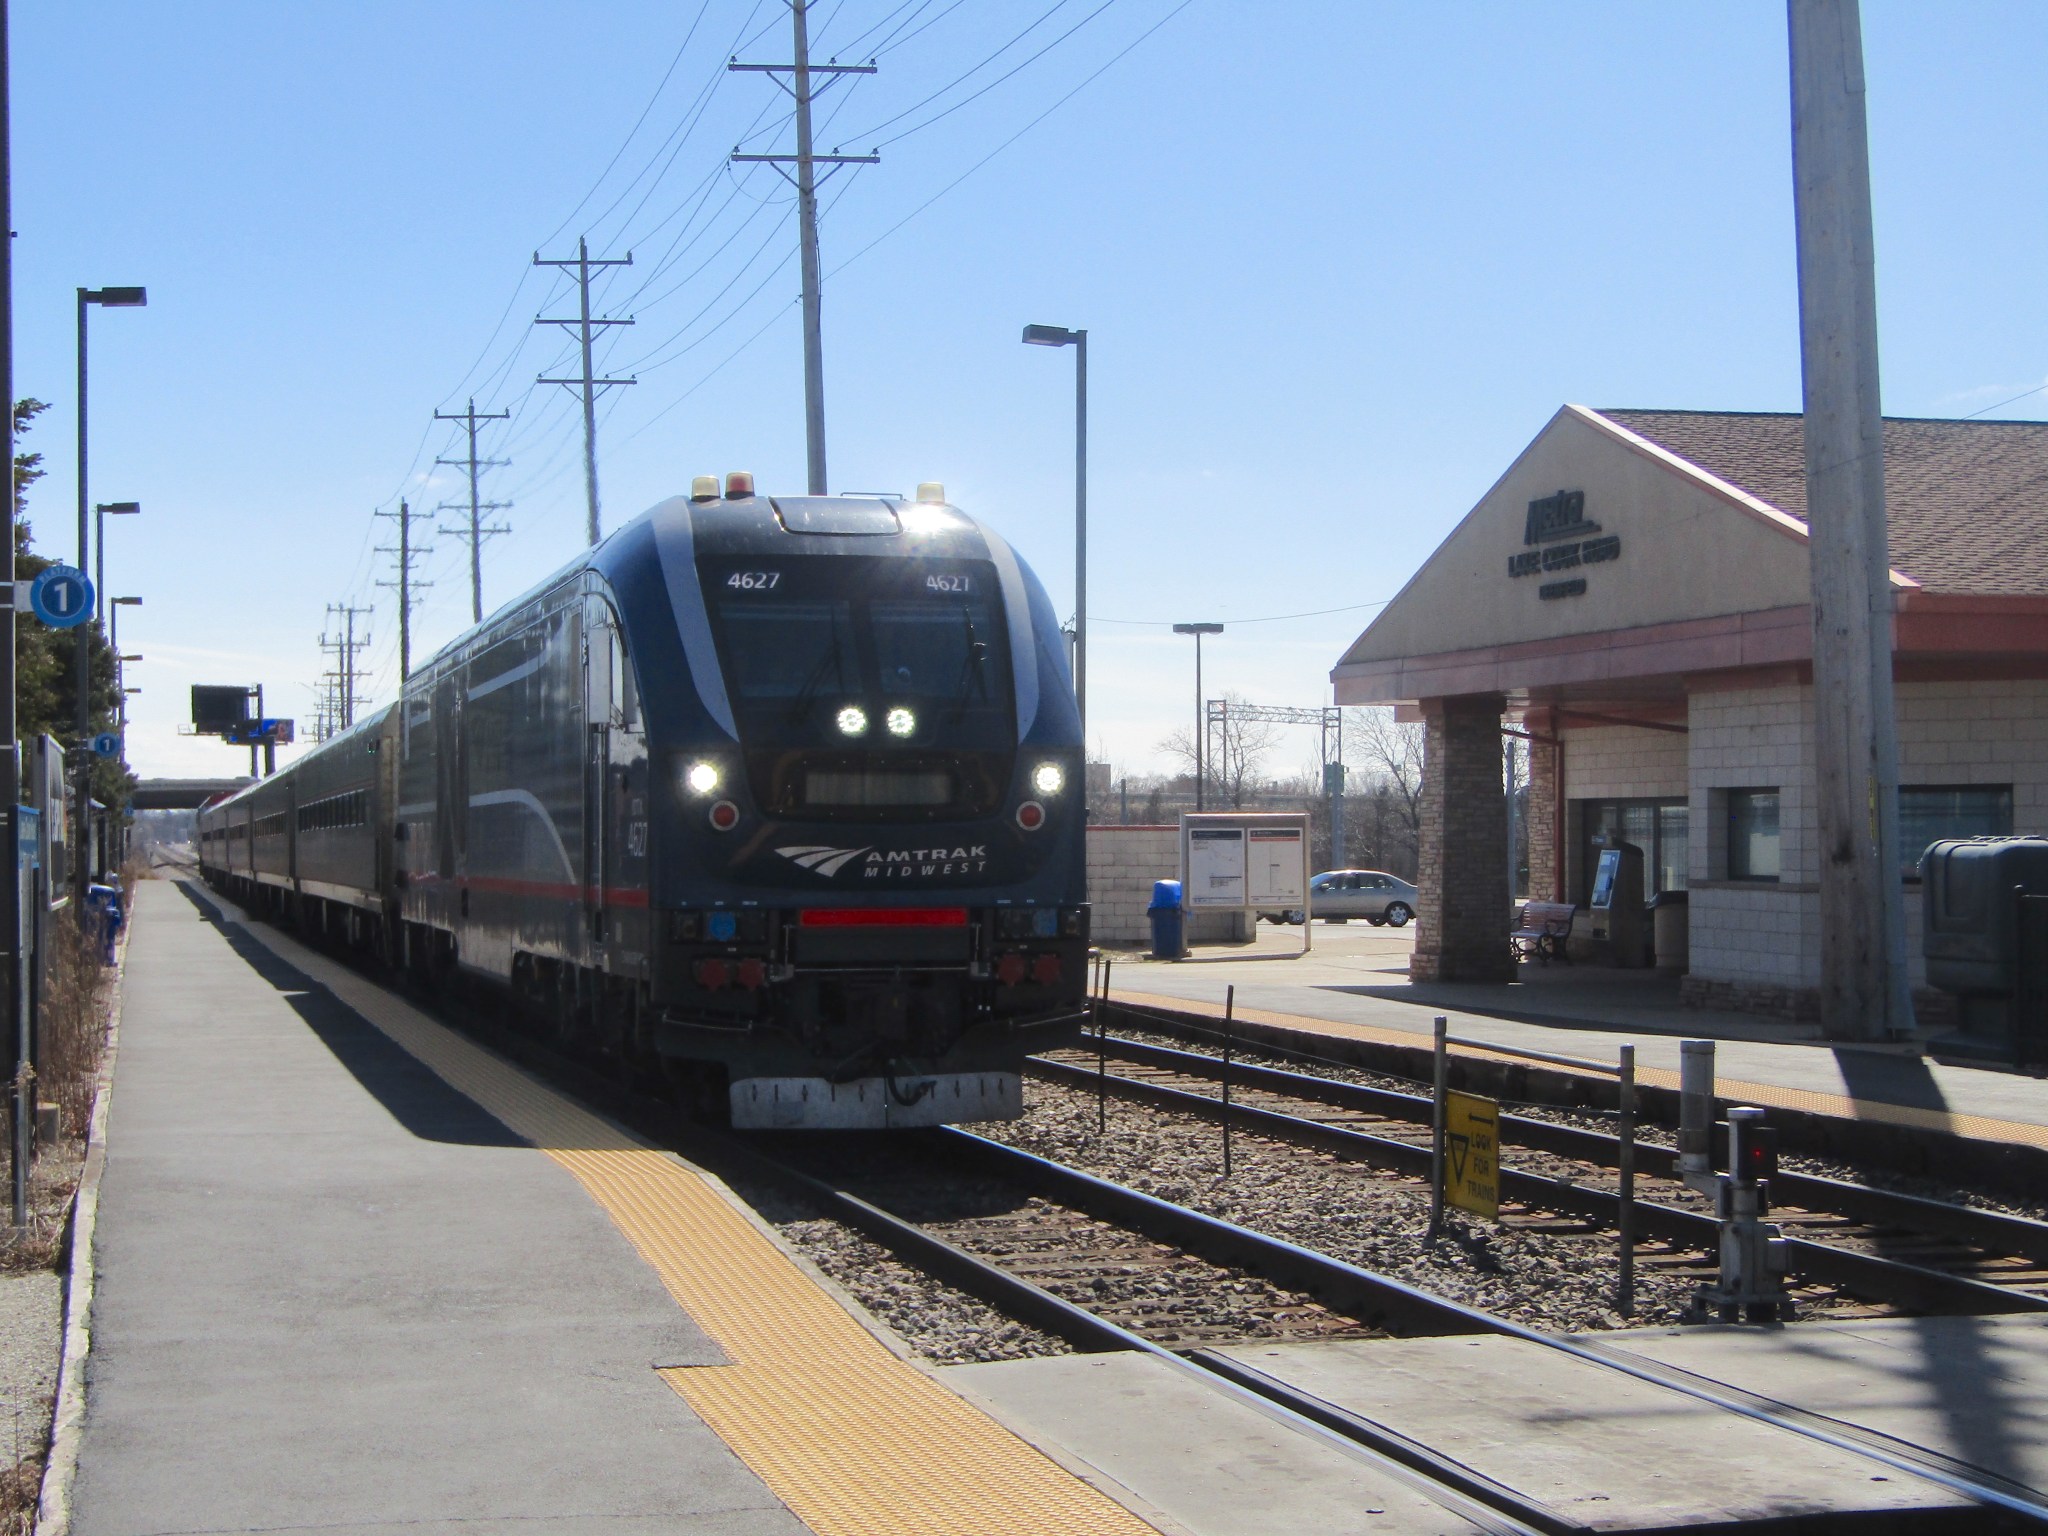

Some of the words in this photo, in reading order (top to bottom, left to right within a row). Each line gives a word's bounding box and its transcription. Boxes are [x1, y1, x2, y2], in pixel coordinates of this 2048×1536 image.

[38, 567, 87, 583] PLATFORM
[727, 573, 780, 589] 4627
[926, 575, 970, 592] 4627
[54, 582, 67, 612] 1
[103, 739, 110, 752] 1
[866, 845, 986, 862] AMTRAK
[864, 861, 986, 877] MIDWEST
[1471, 1132, 1491, 1152] LOOK
[1473, 1157, 1489, 1177] FOR
[1466, 1180, 1495, 1202] TRAINS
